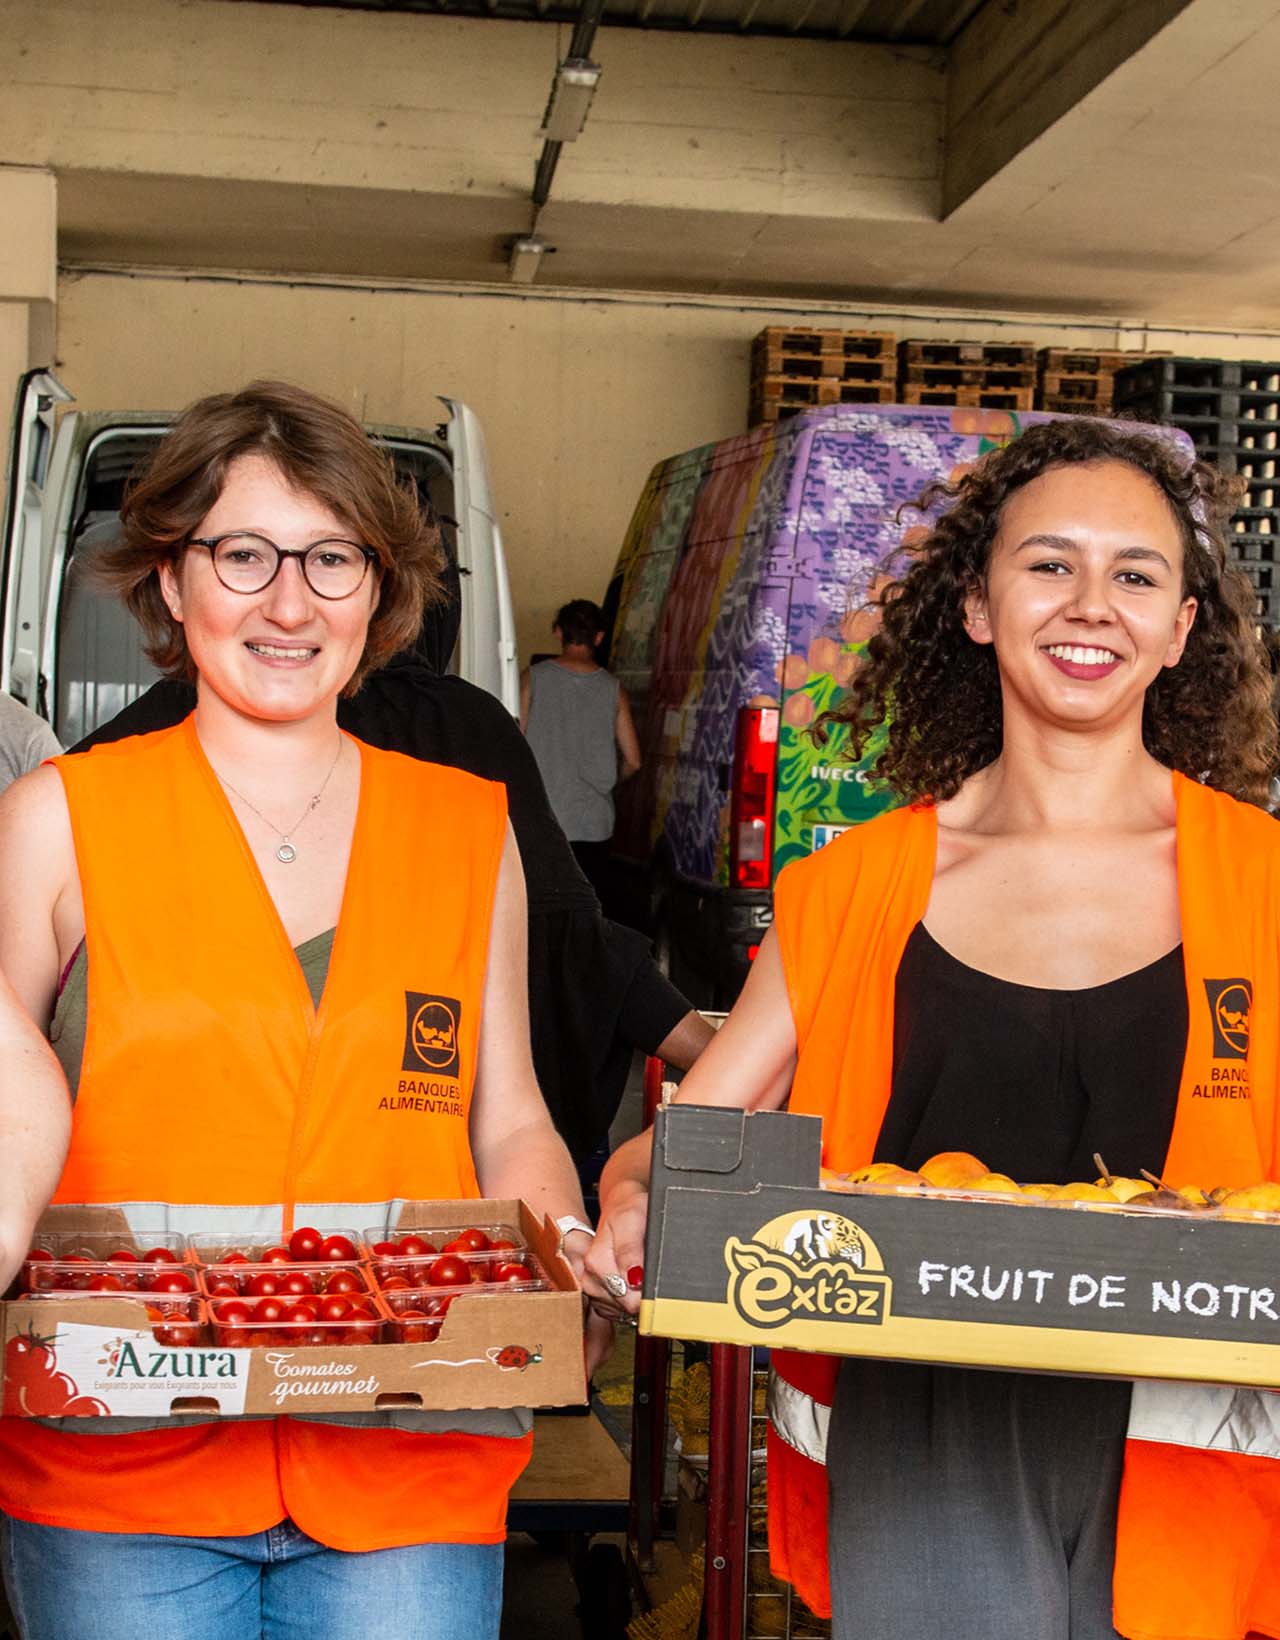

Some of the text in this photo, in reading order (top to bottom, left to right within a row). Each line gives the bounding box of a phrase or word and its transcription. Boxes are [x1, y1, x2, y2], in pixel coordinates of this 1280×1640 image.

[398, 1080, 460, 1100] BANQUES
[918, 1259, 1054, 1305] FRUIT
[1068, 1273, 1127, 1308] DE
[114, 1340, 238, 1378] Azura
[264, 1352, 357, 1378] Tomates
[269, 1375, 380, 1405] gourmet
